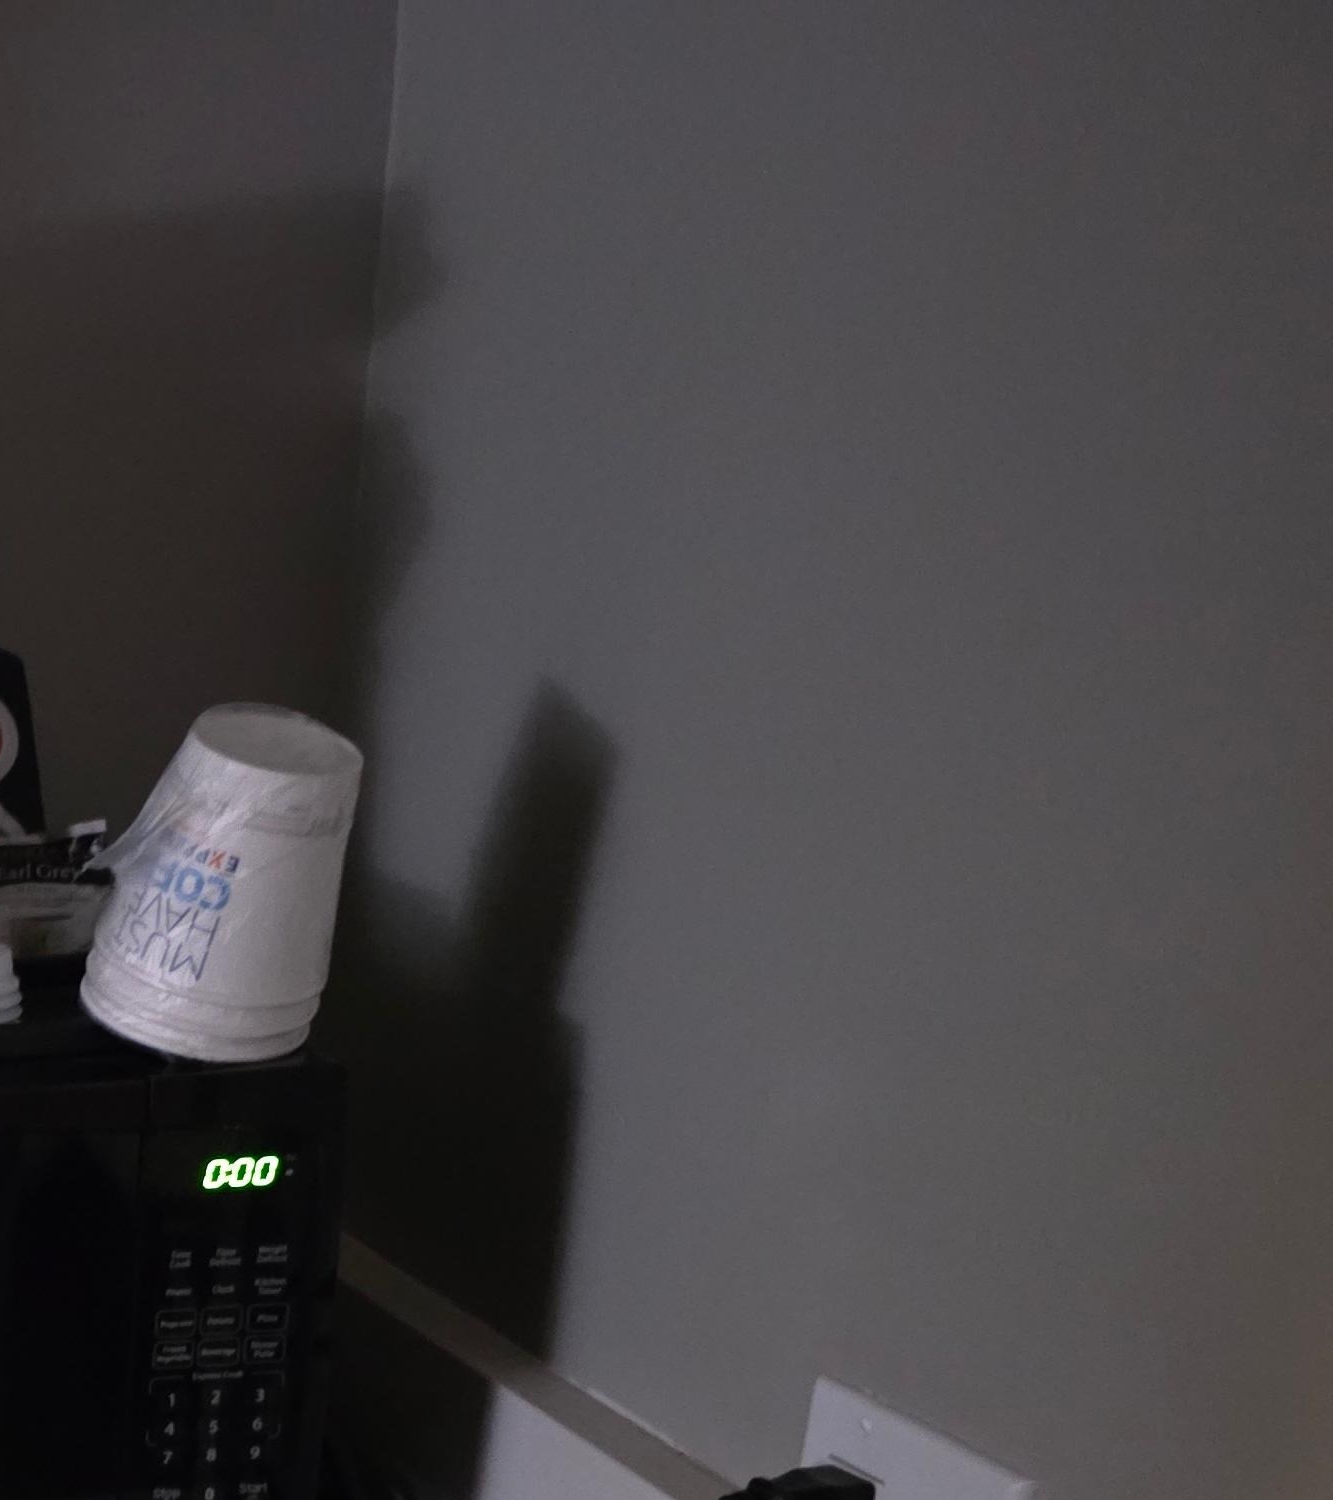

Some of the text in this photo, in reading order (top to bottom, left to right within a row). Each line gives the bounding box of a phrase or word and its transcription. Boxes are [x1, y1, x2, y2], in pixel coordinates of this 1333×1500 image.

[203, 1155, 279, 1189] 0:00
[166, 1387, 266, 1408] 1 2 3
[164, 1416, 264, 1436] 4 5 6
[162, 1445, 261, 1465] 7 8 9
[238, 1482, 269, 1495] Start
